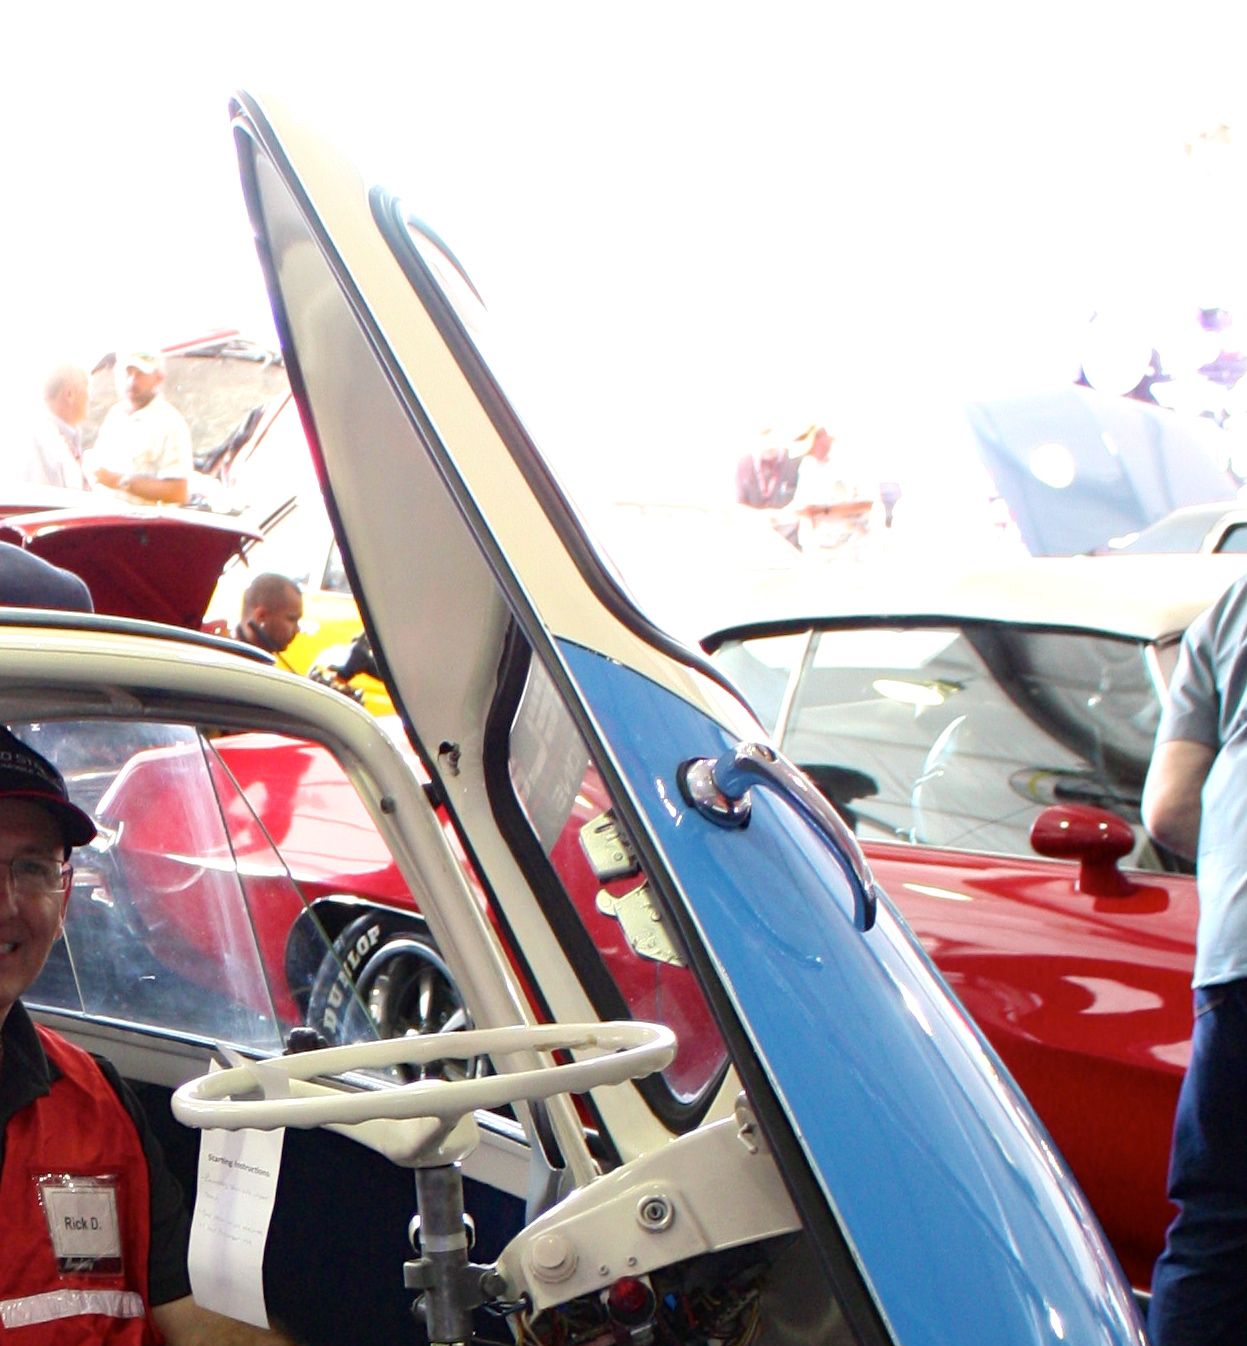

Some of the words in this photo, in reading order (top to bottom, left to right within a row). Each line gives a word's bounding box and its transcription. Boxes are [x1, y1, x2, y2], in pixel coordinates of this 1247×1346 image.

[323, 925, 380, 1033] DUNLOP
[208, 1153, 233, 1168] Starting
[64, 1215, 88, 1231] Rick
[90, 1217, 102, 1231] D.
